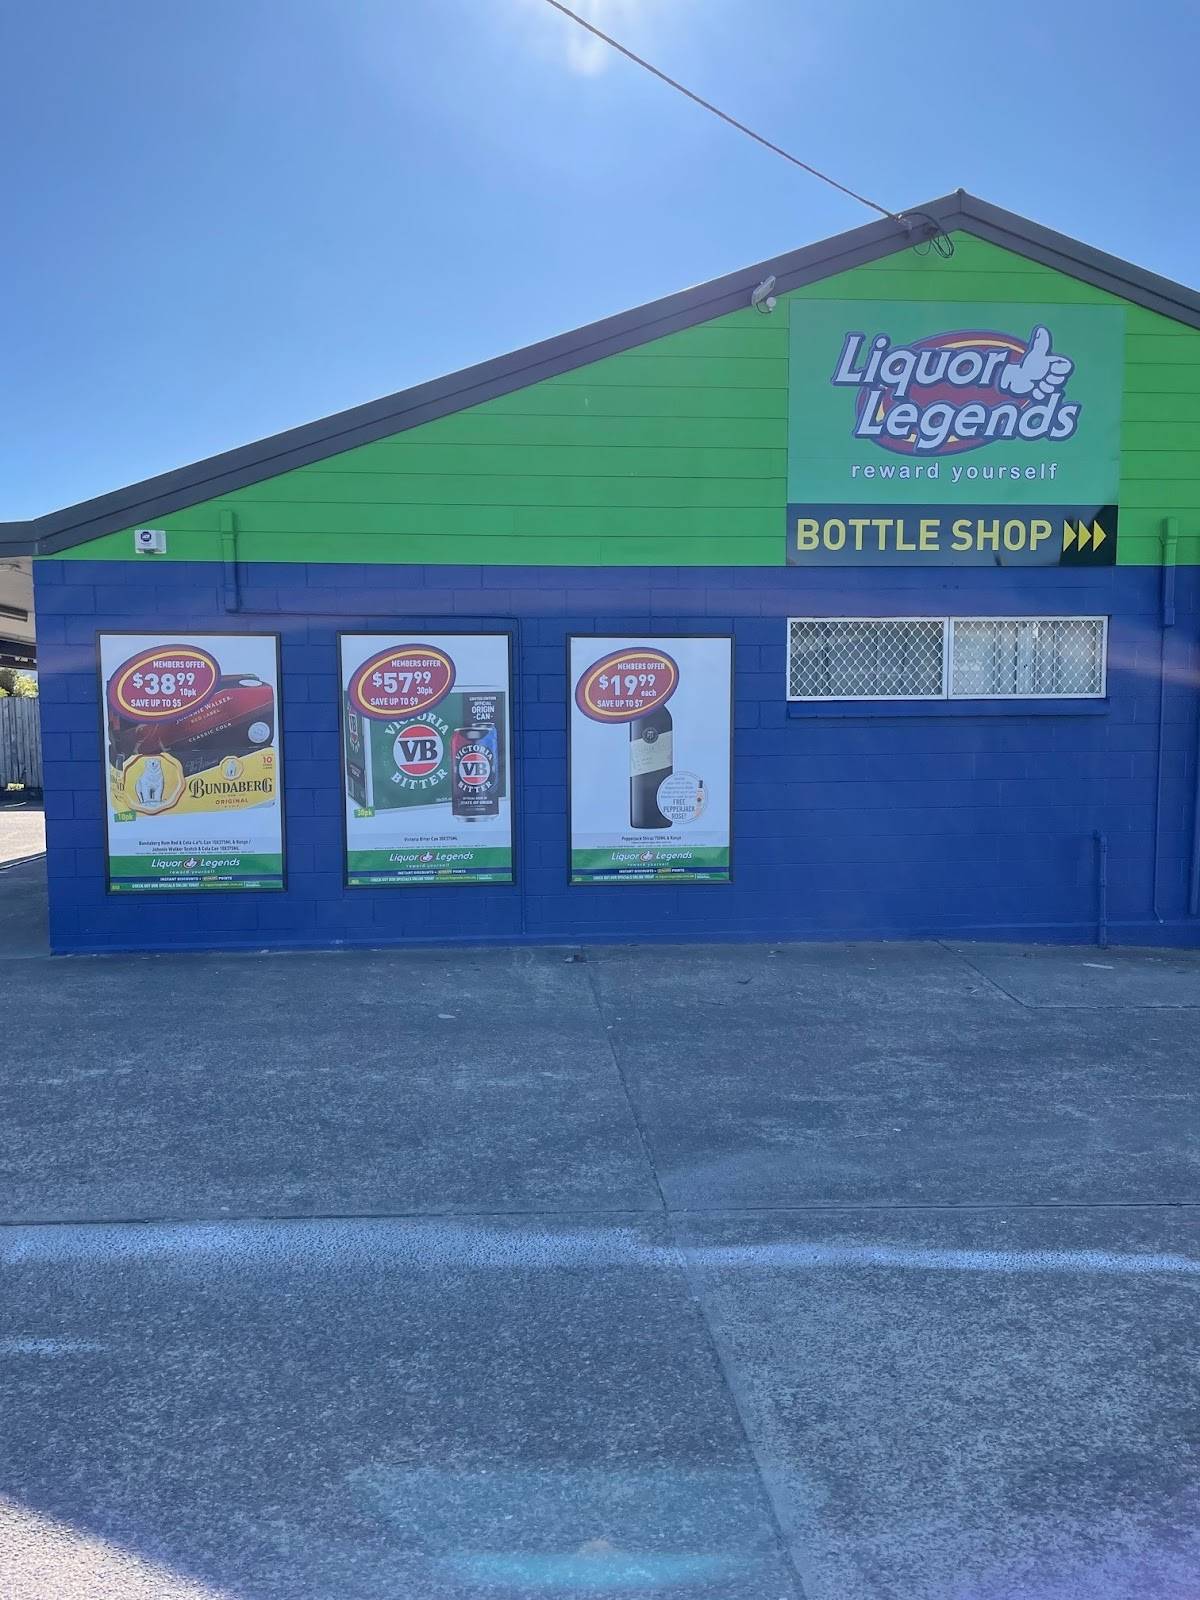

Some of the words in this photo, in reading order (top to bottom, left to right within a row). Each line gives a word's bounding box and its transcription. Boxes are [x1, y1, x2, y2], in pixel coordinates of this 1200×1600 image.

[834, 334, 1008, 397] Liquor
[856, 390, 1079, 449] Legends
[851, 463, 939, 479] reward
[952, 463, 1058, 482] yourself
[797, 518, 940, 551] BOTTLE
[951, 518, 1052, 551] SHOP
[153, 660, 184, 669] MEMBERS
[185, 660, 205, 669] OFFER
[391, 660, 421, 668] MEMBERS
[422, 659, 441, 668] OFFER
[179, 688, 197, 698] 10pk
[417, 687, 433, 696] 30pk
[641, 689, 657, 697] each
[131, 699, 149, 708] SAVE
[151, 699, 160, 708] UP
[162, 699, 171, 707] TO
[172, 698, 182, 708] $5
[370, 697, 388, 706] SAVE
[389, 697, 398, 706] UP
[400, 697, 409, 705] TO
[410, 696, 418, 706] $9
[597, 700, 614, 708] SAVE
[625, 700, 634, 708] TO
[634, 699, 643, 708] $7
[472, 706, 494, 714] ORIGIN
[188, 729, 214, 743] CLASSIC
[215, 722, 232, 732] COLA
[398, 739, 438, 762] VB
[456, 744, 493, 760] VICTORIA
[263, 756, 272, 764] 10
[462, 762, 488, 776] VB
[392, 768, 450, 790] BITTER
[189, 778, 272, 799] BUNDABERG
[458, 781, 492, 794] BITTER
[389, 852, 418, 863] Liquor
[436, 851, 474, 862] Legends
[611, 852, 640, 861] Liquor
[656, 851, 692, 860] Legends
[152, 858, 182, 868] Liquor
[200, 858, 240, 868] Legends
